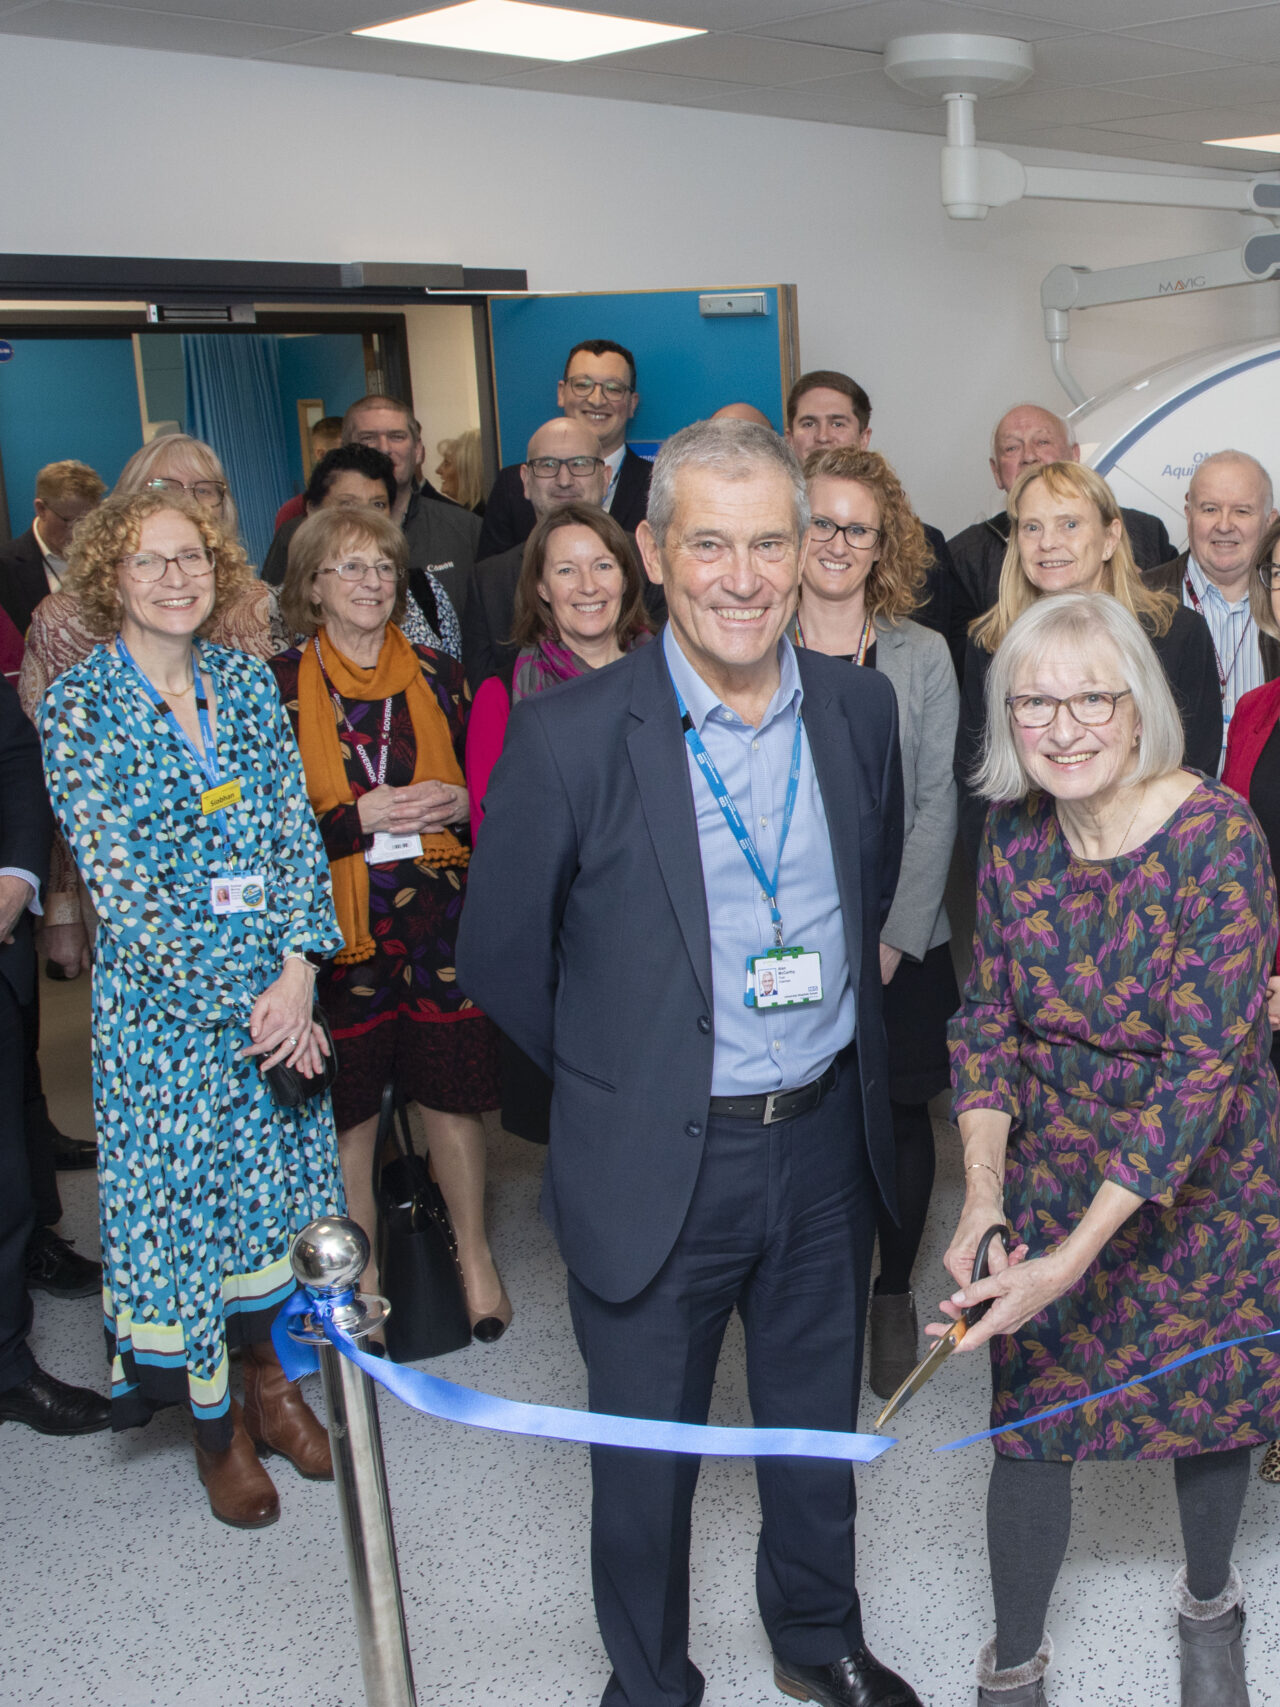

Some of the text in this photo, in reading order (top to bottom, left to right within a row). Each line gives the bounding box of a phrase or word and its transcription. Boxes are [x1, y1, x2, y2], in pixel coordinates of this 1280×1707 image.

[1158, 275, 1206, 293] MAVIG
[426, 560, 455, 572] Canon
[383, 697, 392, 731] GOVERNO
[356, 744, 377, 783] GOVERNOR
[378, 744, 388, 785] GOVERNOR
